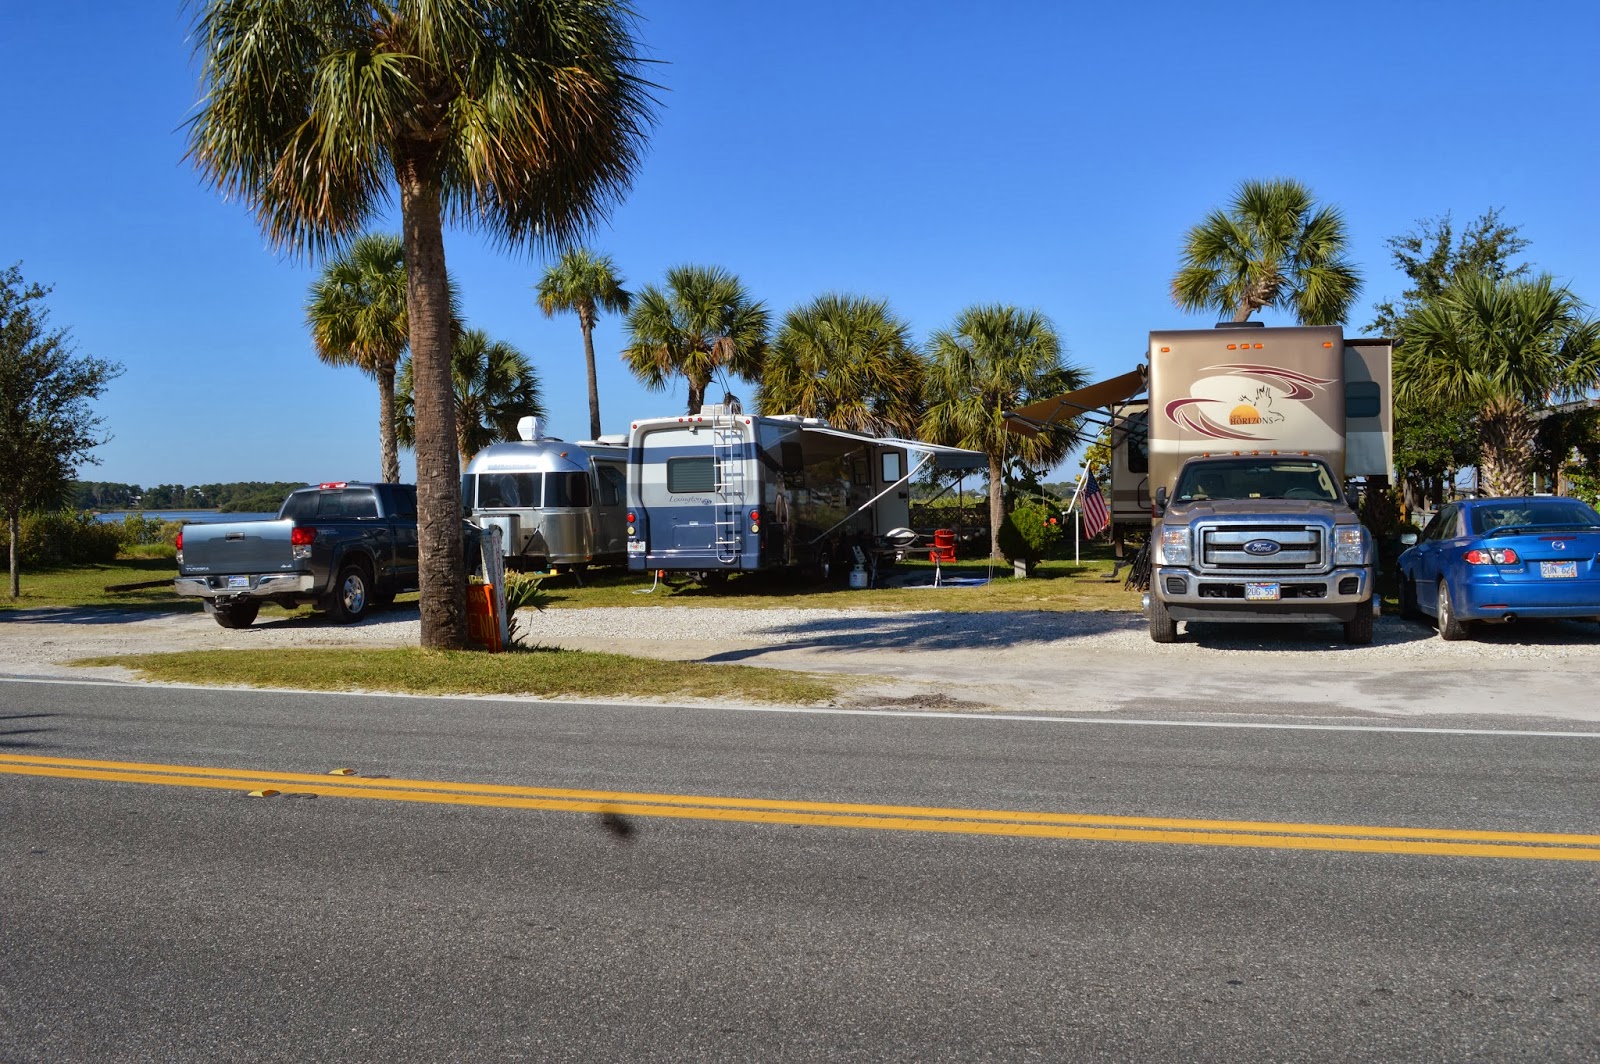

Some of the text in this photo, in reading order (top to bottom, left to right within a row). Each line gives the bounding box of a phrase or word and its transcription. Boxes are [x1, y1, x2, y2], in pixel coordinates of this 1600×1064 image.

[1230, 416, 1274, 425] HORIZONS
[669, 495, 702, 505] Lexington
[1252, 543, 1272, 551] Ford
